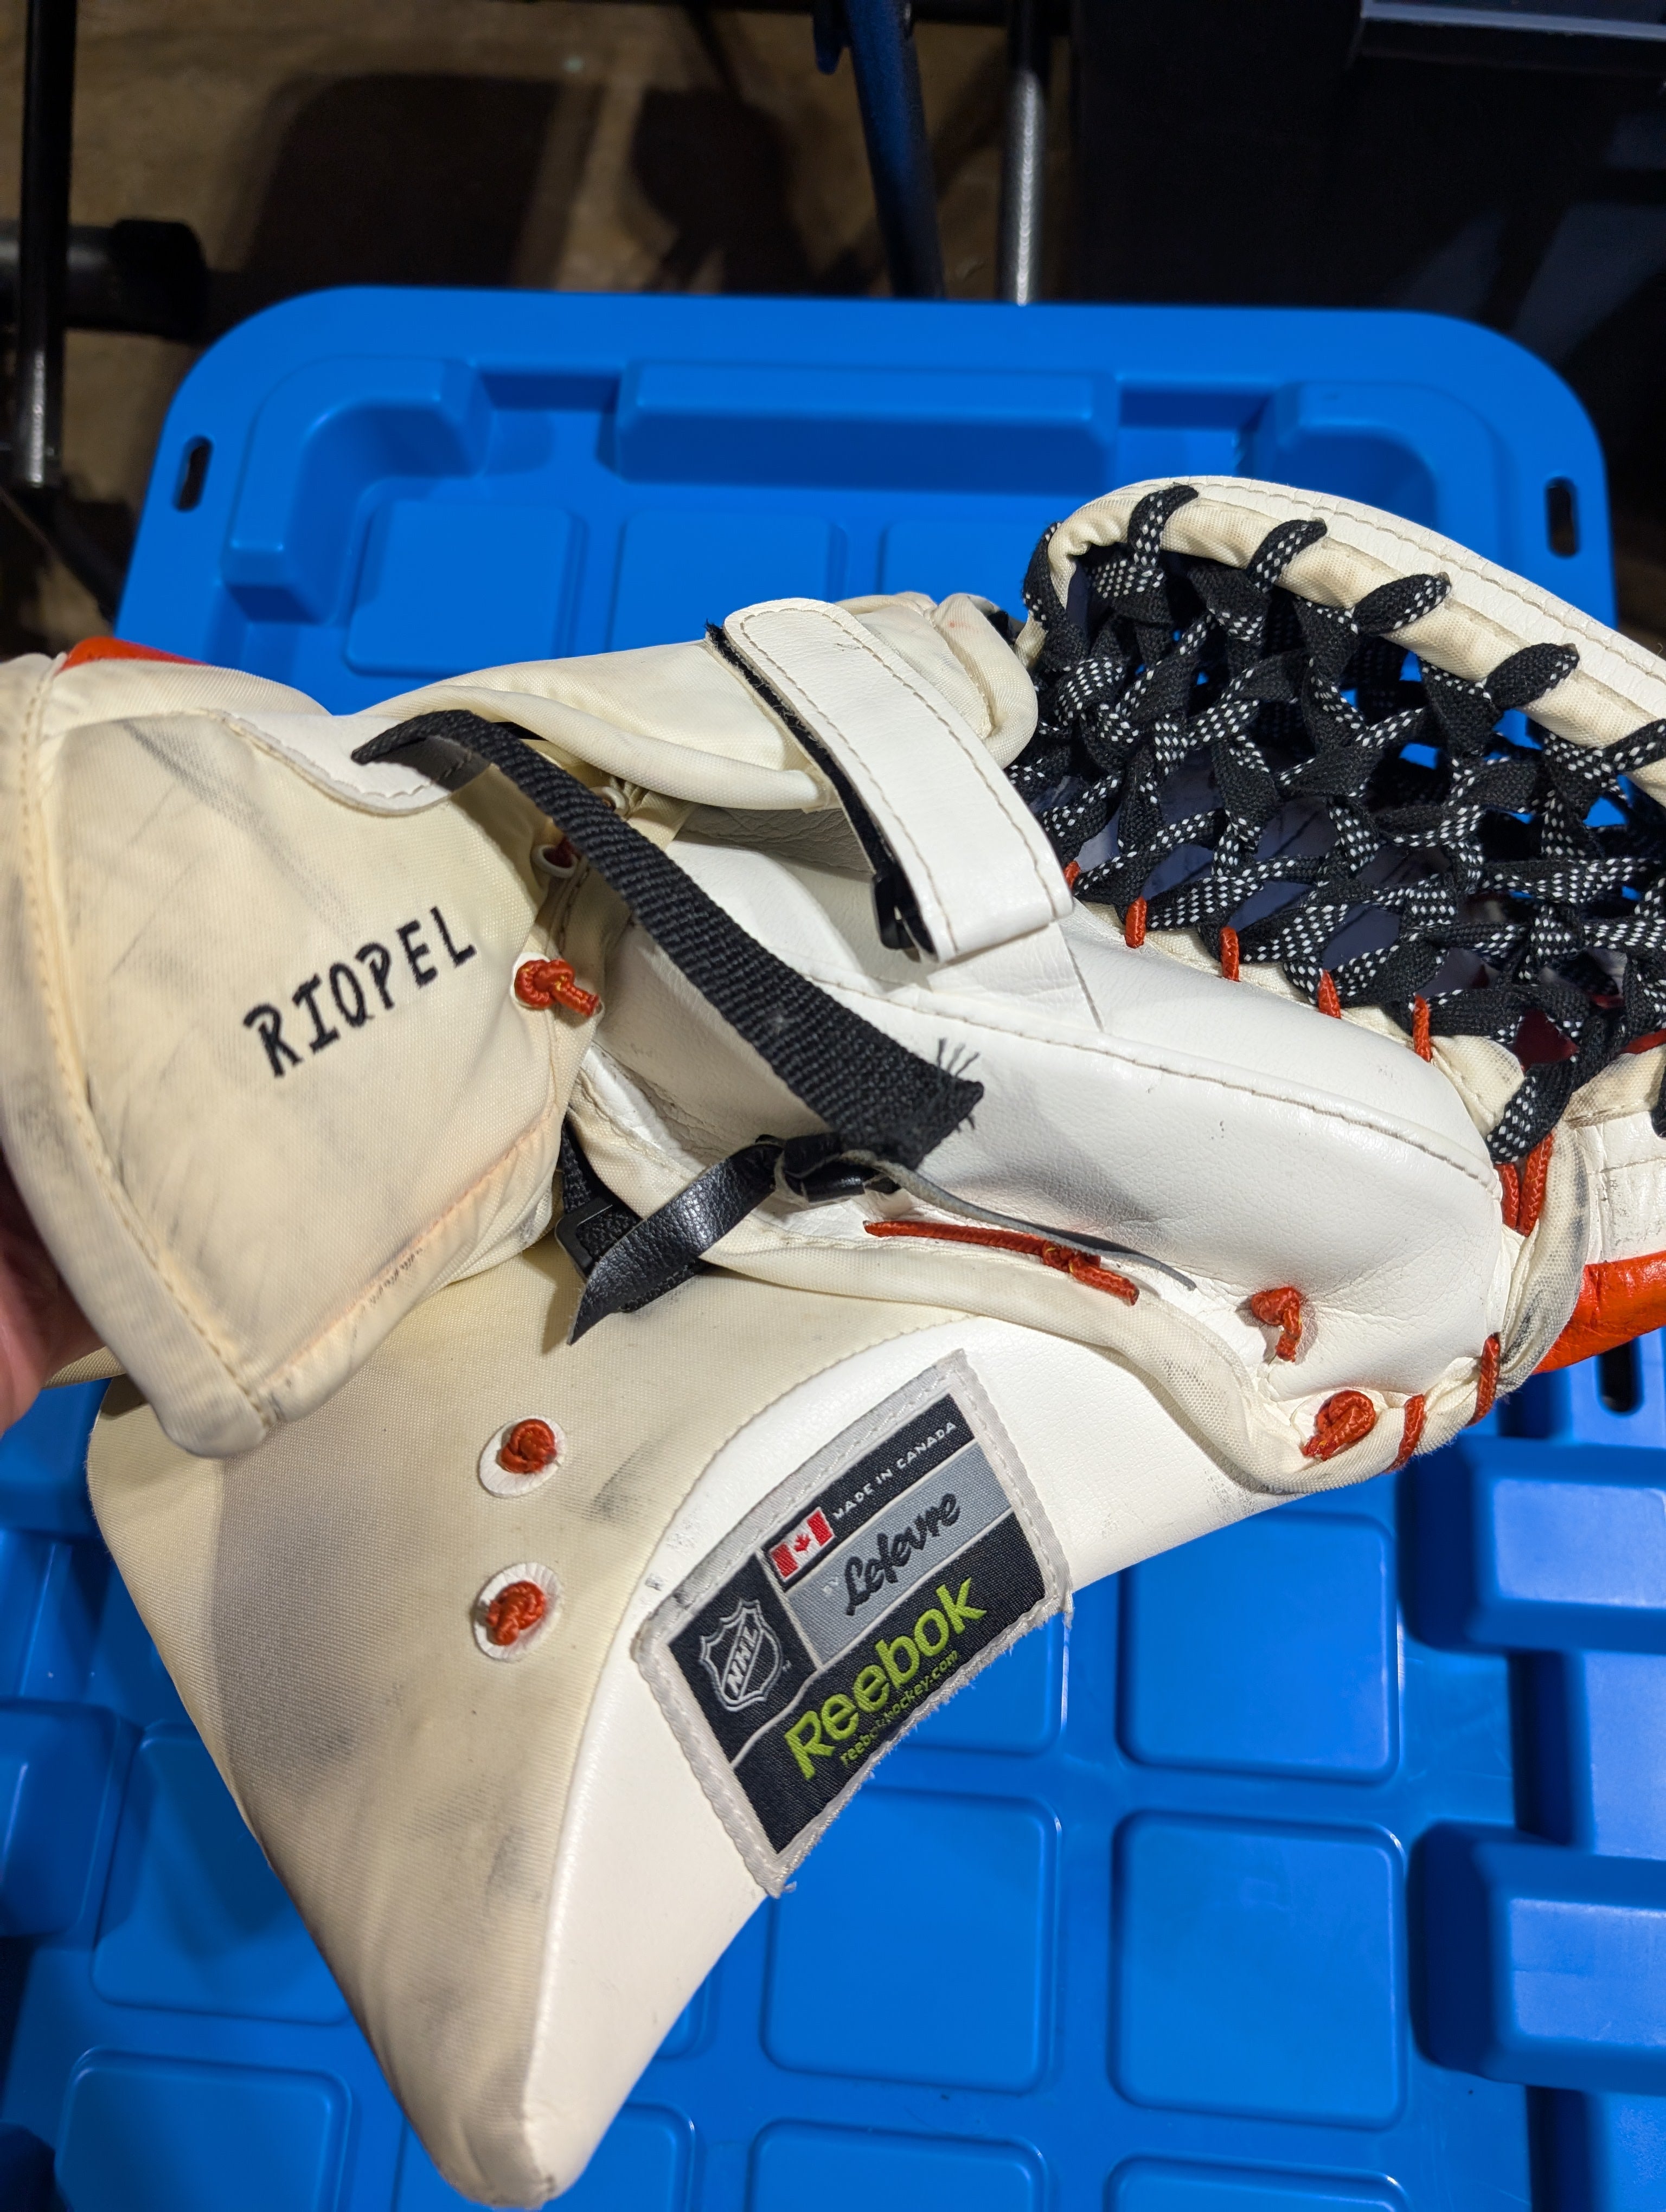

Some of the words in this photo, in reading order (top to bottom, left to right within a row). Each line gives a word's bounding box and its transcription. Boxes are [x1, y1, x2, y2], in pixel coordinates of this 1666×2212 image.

[243, 906, 476, 1077] RIOPEL
[832, 1482, 875, 1519] MADE
[875, 1468, 894, 1484] IN
[896, 1422, 956, 1469] CANADA
[844, 1493, 960, 1616] Lefevre
[727, 1625, 758, 1696] NHL
[784, 1577, 988, 1780] Reebok
[840, 1650, 958, 1767] reebokhockey.com
